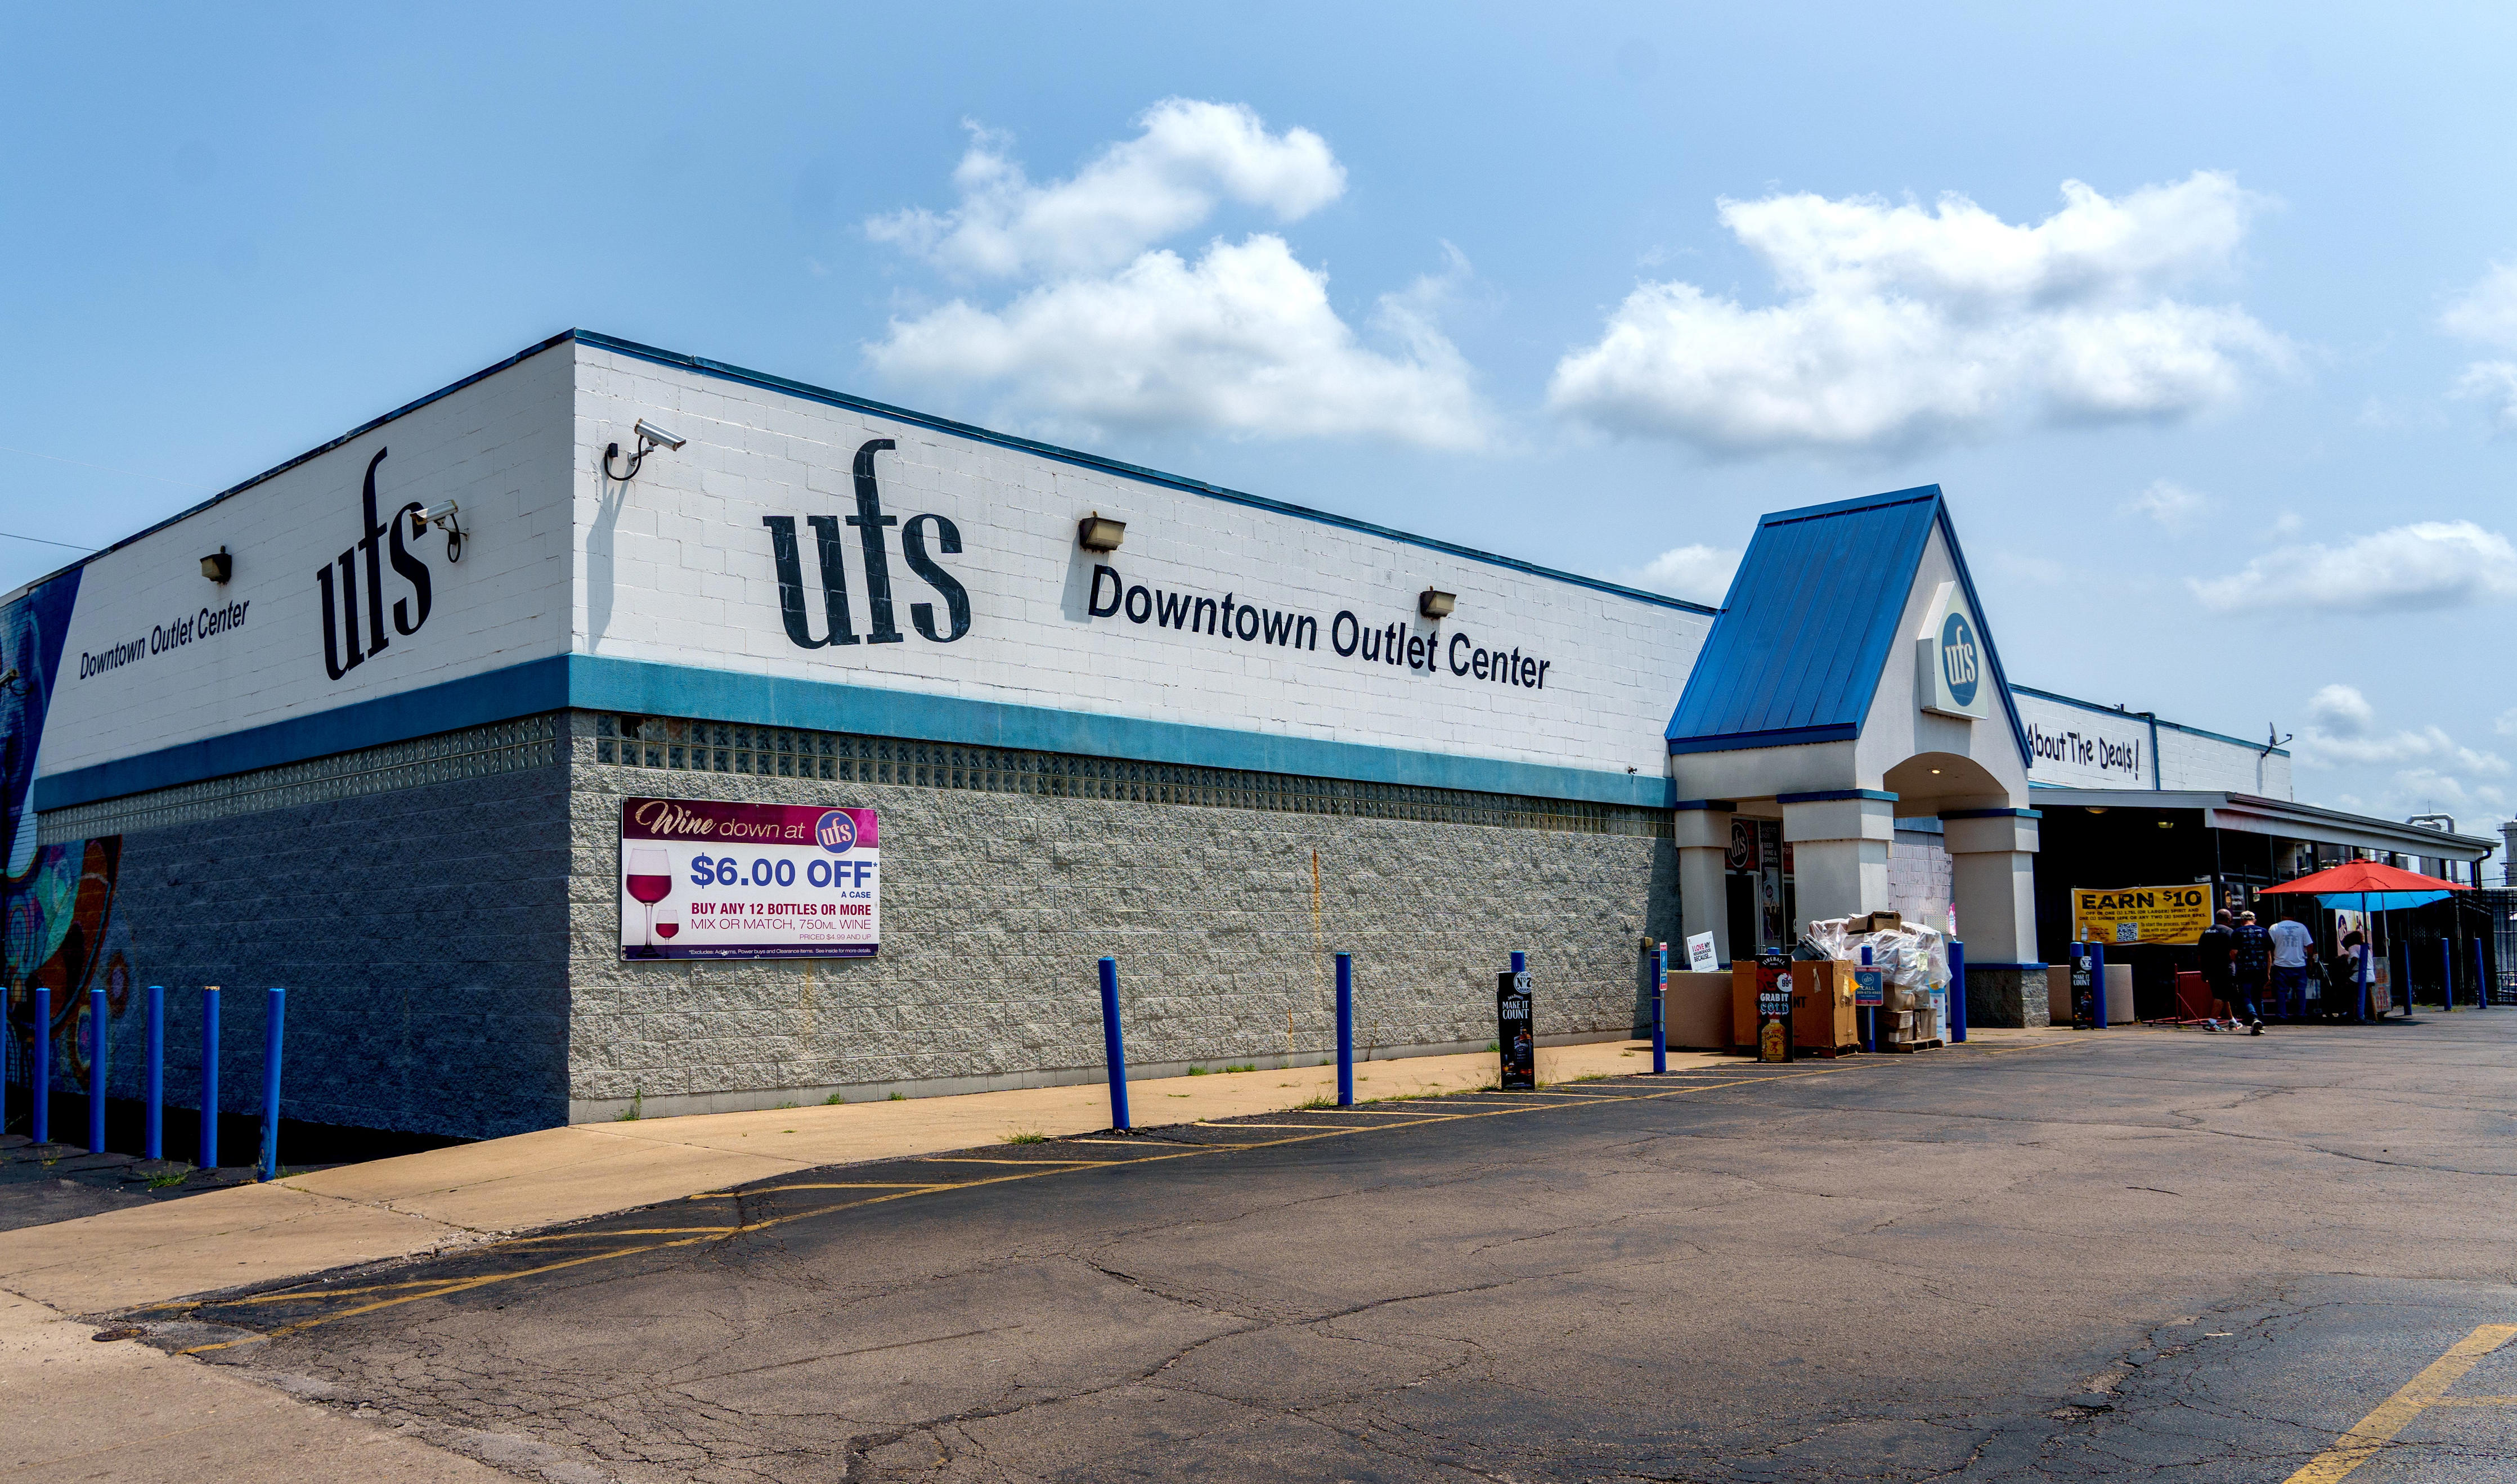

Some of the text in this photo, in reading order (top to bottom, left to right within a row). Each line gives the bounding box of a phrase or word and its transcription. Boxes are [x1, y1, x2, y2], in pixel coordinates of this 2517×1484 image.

[762, 438, 972, 649] ufs
[317, 446, 432, 681] ufs
[1088, 564, 1551, 690] Downtown Outlet Center
[79, 599, 250, 680] Downtown Outlet Center
[1944, 624, 1976, 686] ufs
[2027, 722, 2066, 762] About
[2067, 731, 2094, 766] The
[635, 801, 806, 839] Wine down at
[820, 817, 853, 846] ufs
[690, 852, 796, 889] $6.00
[691, 902, 871, 915] BUY ANY 12 BOTTLES OR MORE
[2081, 890, 2202, 910] EARN $10
[691, 919, 716, 929] MIX
[719, 919, 740, 929] OR
[744, 919, 795, 930] MATCH,
[839, 919, 871, 929] WINE
[1693, 948, 1711, 956] NEIGHBORHOOD
[1762, 956, 1785, 966] FIREBALL
[1502, 1000, 1529, 1009] MAKE IT
[1760, 993, 1789, 1002] GRAB IT
[1760, 1002, 1789, 1015] COLD
[1502, 1009, 1529, 1019] COUNT
